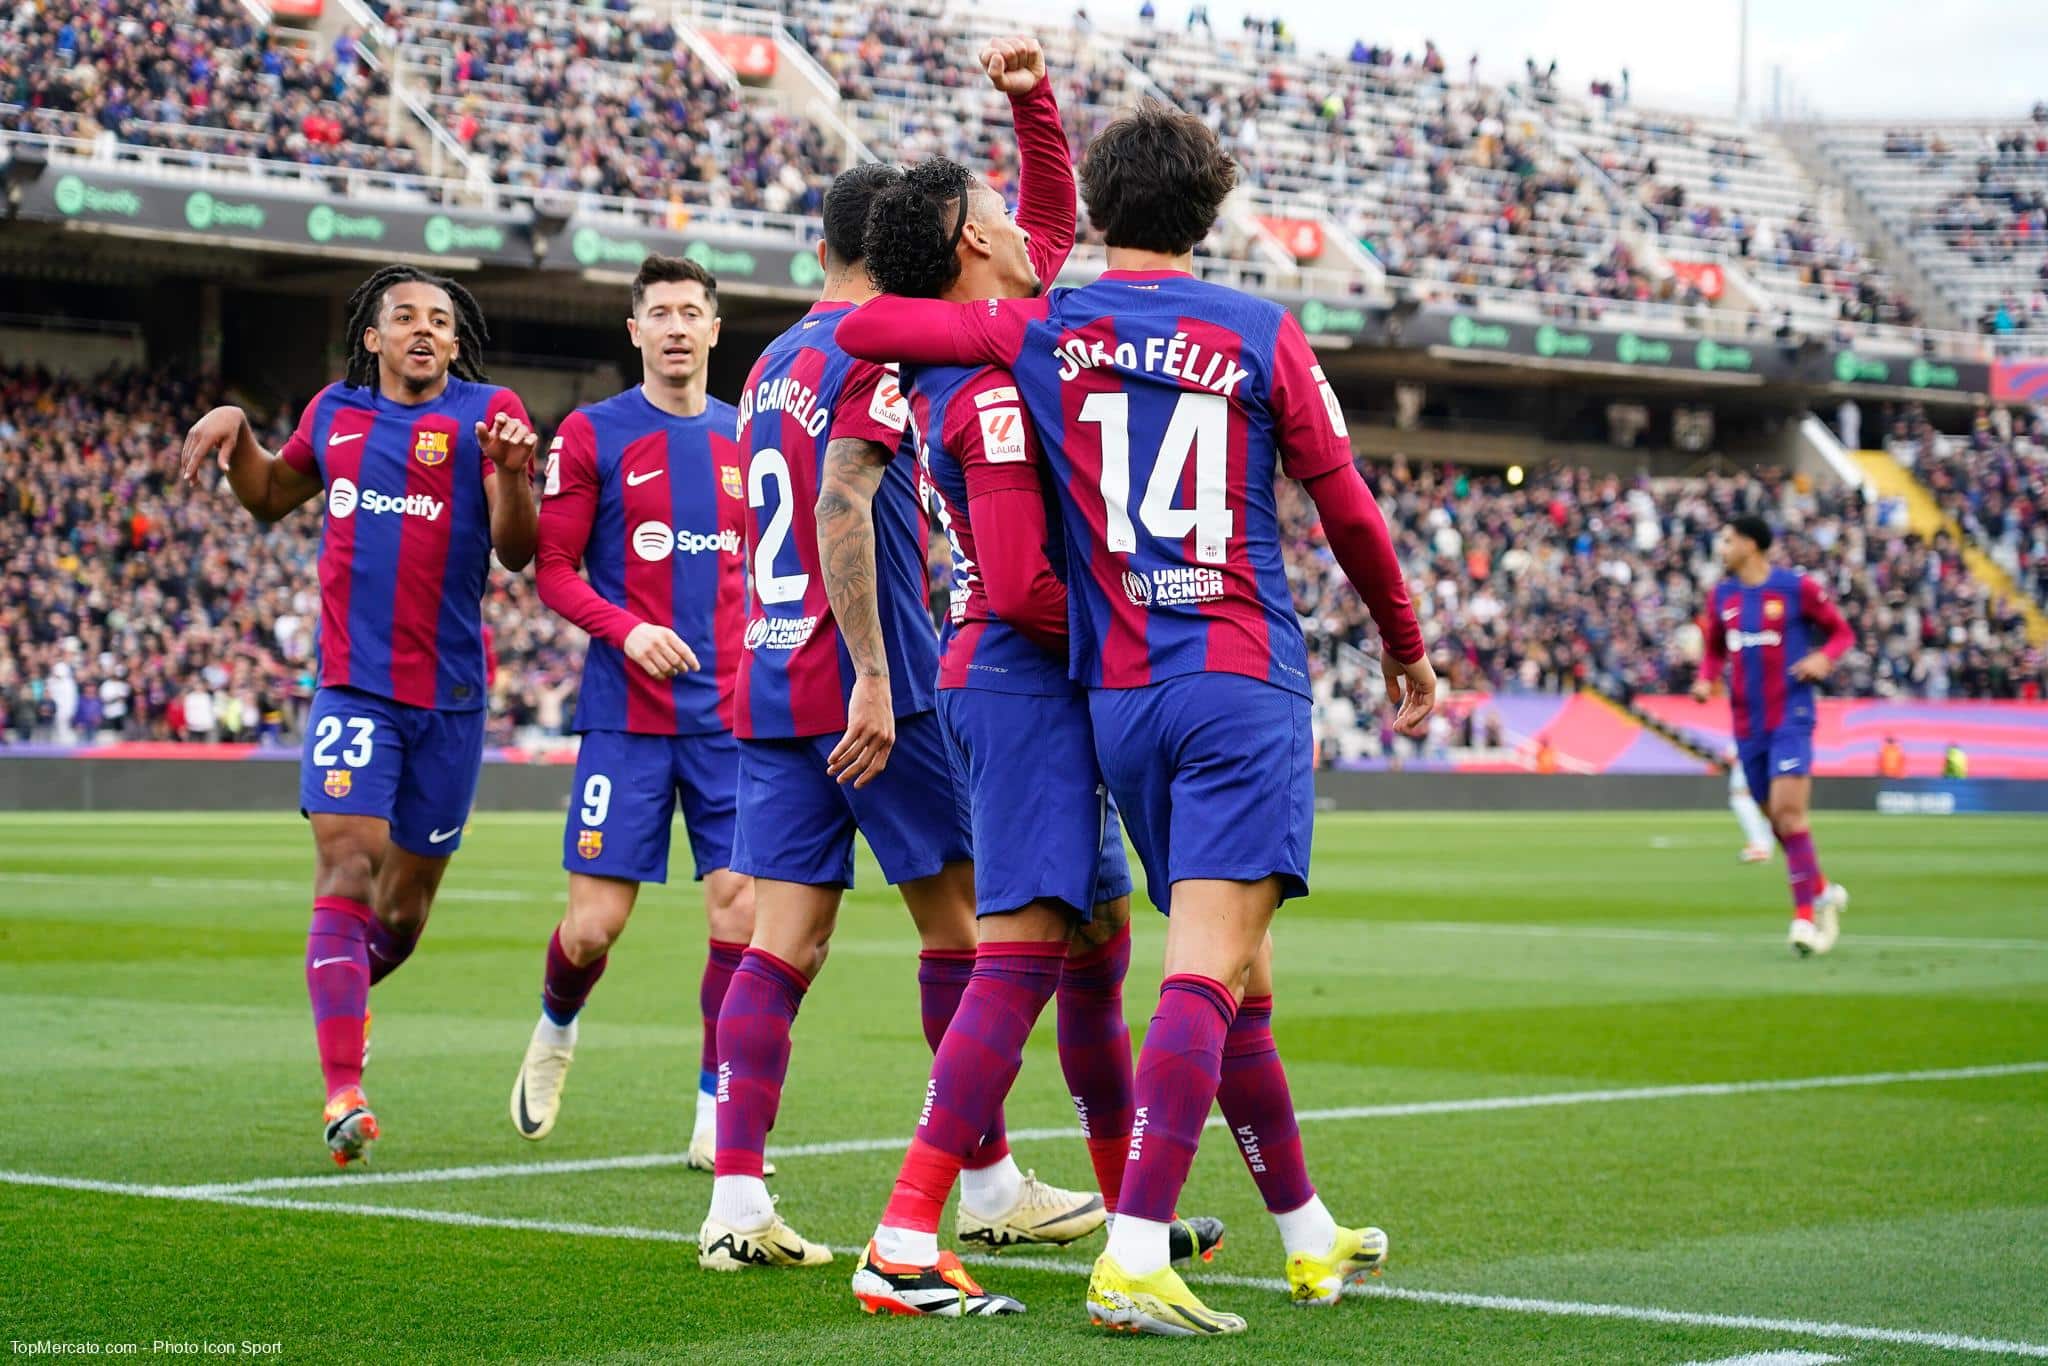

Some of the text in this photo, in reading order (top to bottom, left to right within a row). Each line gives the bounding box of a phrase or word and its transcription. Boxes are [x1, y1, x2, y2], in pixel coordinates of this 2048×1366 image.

[1145, 332, 1249, 396] FÉLIX
[756, 377, 829, 438] CANCELO
[991, 444, 1021, 455] LALIGA
[1078, 392, 1233, 564] 14
[361, 489, 444, 521] Spotify
[748, 447, 809, 605] 2
[1153, 568, 1223, 584] UNHCR
[1156, 580, 1224, 600] ACNUR
[769, 616, 817, 632] UNHCR
[313, 716, 375, 768] 23
[580, 773, 612, 827] 9
[718, 1061, 733, 1103] BARÇA
[918, 1078, 937, 1127] BARÇA
[1128, 1106, 1149, 1161] BARÇA
[1237, 1125, 1267, 1173] BARÇA
